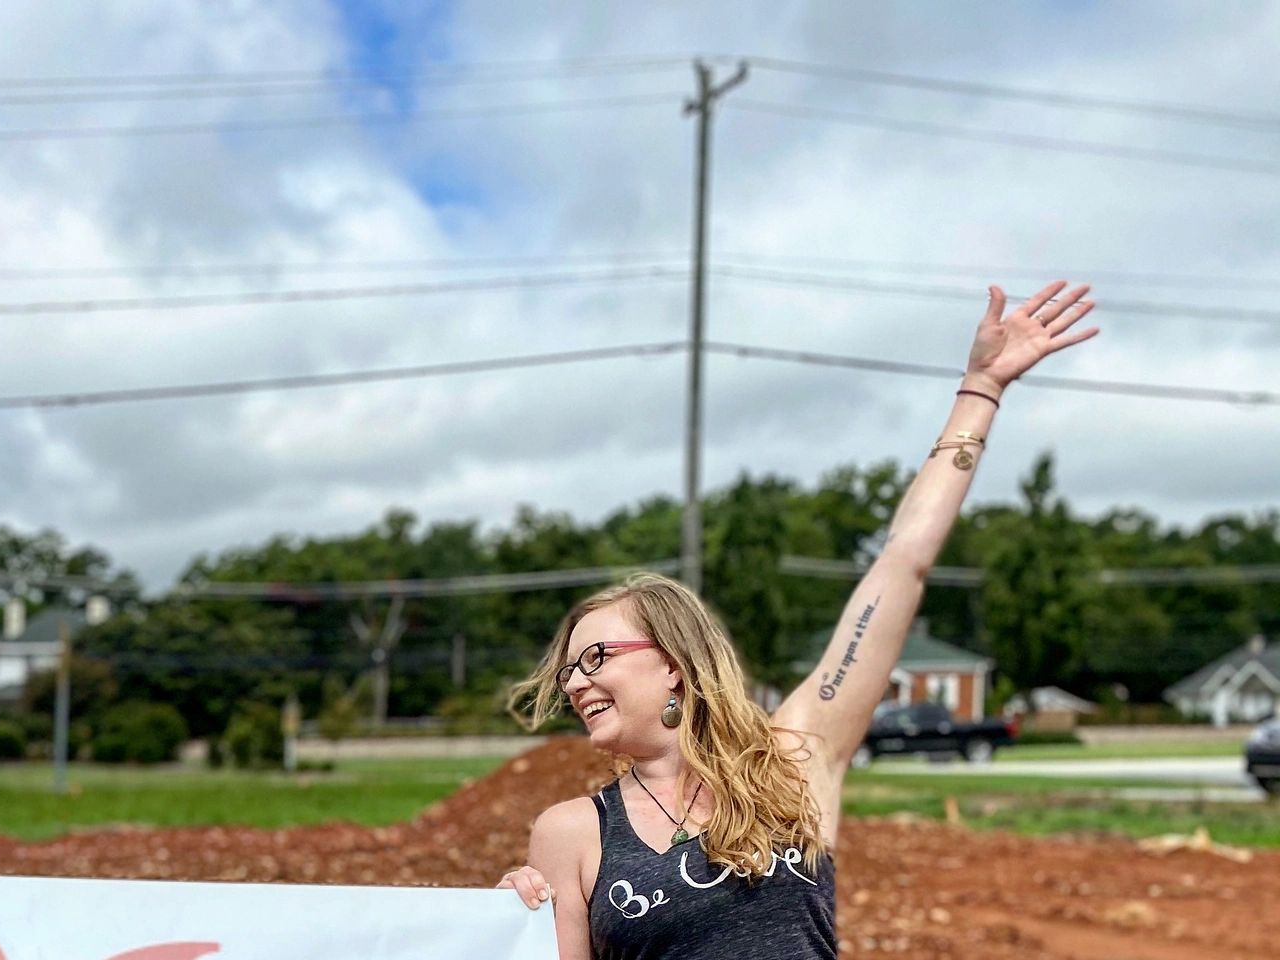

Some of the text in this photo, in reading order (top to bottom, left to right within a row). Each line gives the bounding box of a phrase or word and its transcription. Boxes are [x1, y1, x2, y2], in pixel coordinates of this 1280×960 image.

[842, 641, 858, 667] upon
[854, 630, 863, 639] a
[608, 879, 670, 919] Be
